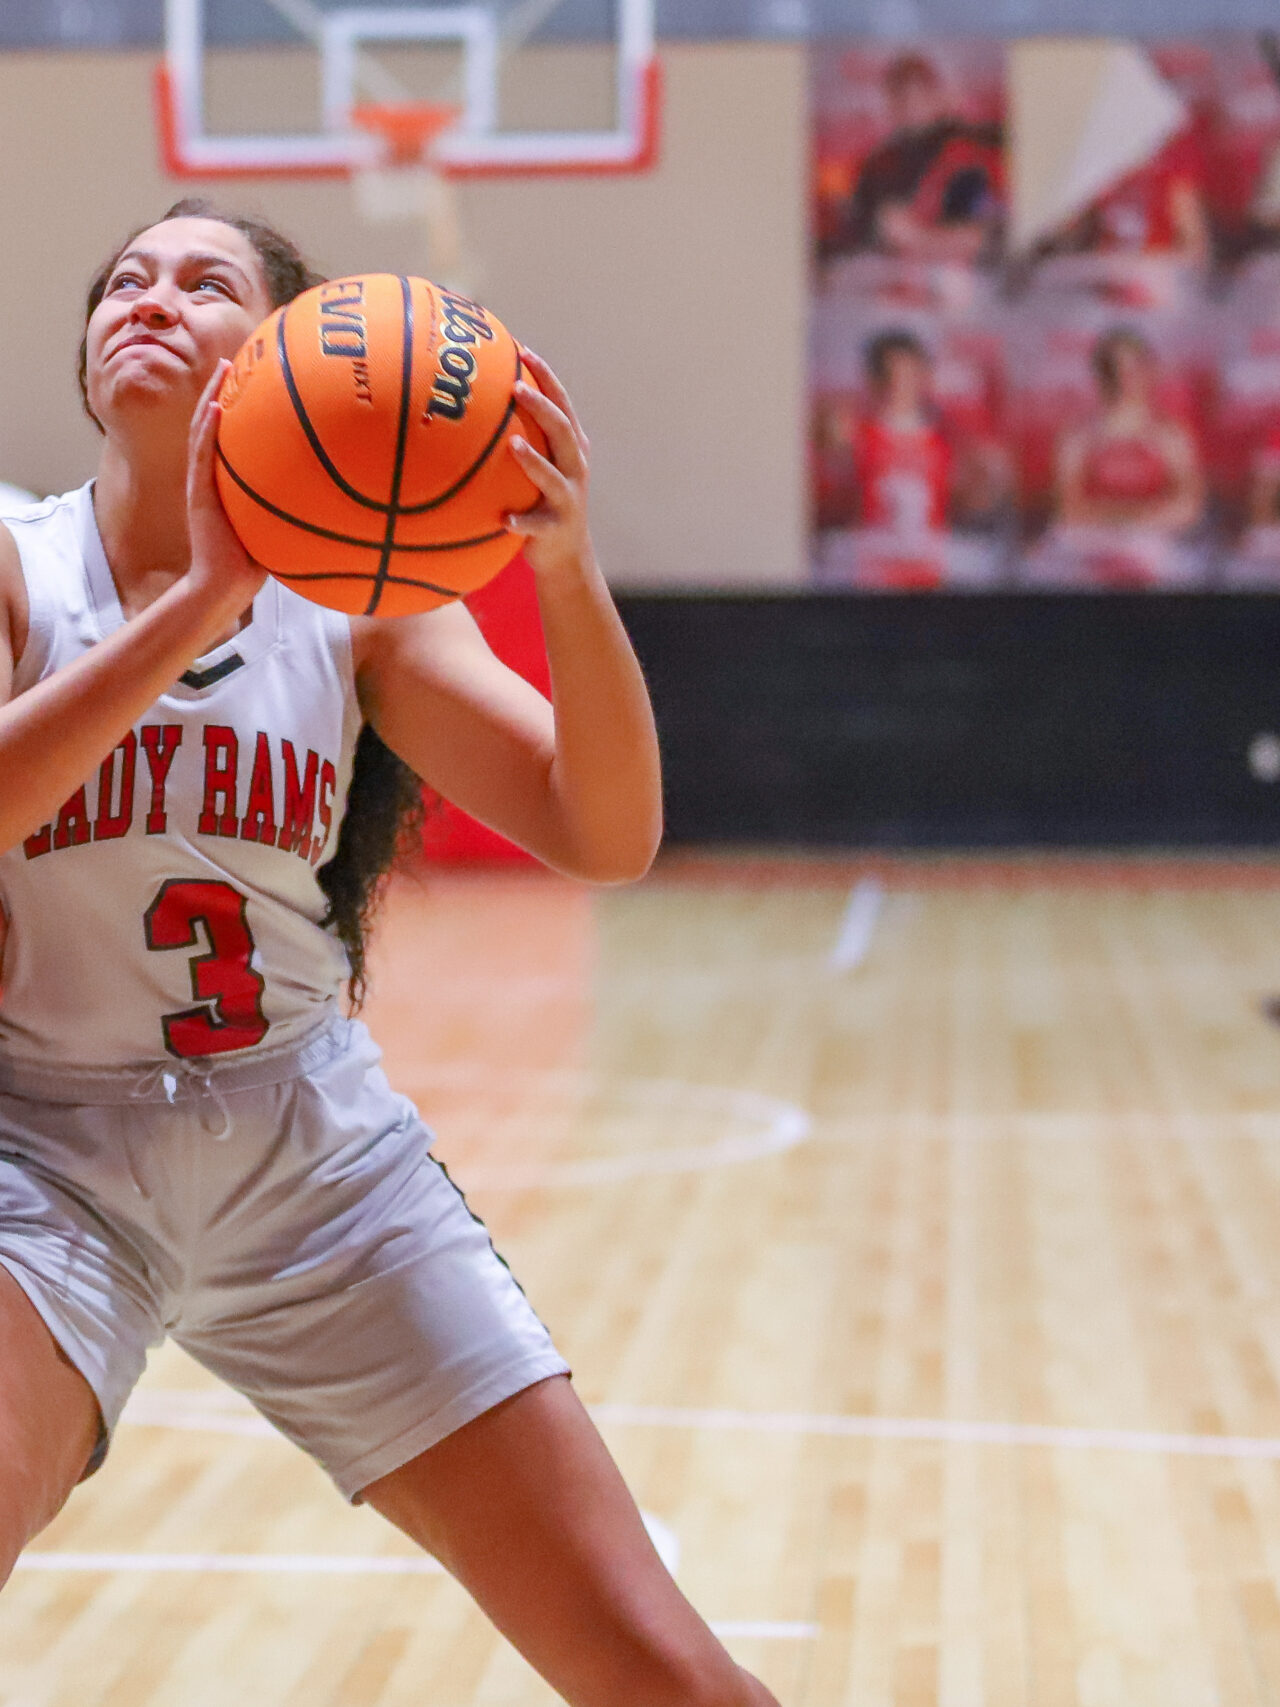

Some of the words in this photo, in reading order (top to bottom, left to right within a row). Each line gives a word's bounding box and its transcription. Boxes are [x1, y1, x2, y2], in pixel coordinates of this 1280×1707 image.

[320, 281, 366, 358] EVO
[197, 724, 338, 866] RAMS
[144, 877, 269, 1058] 3
